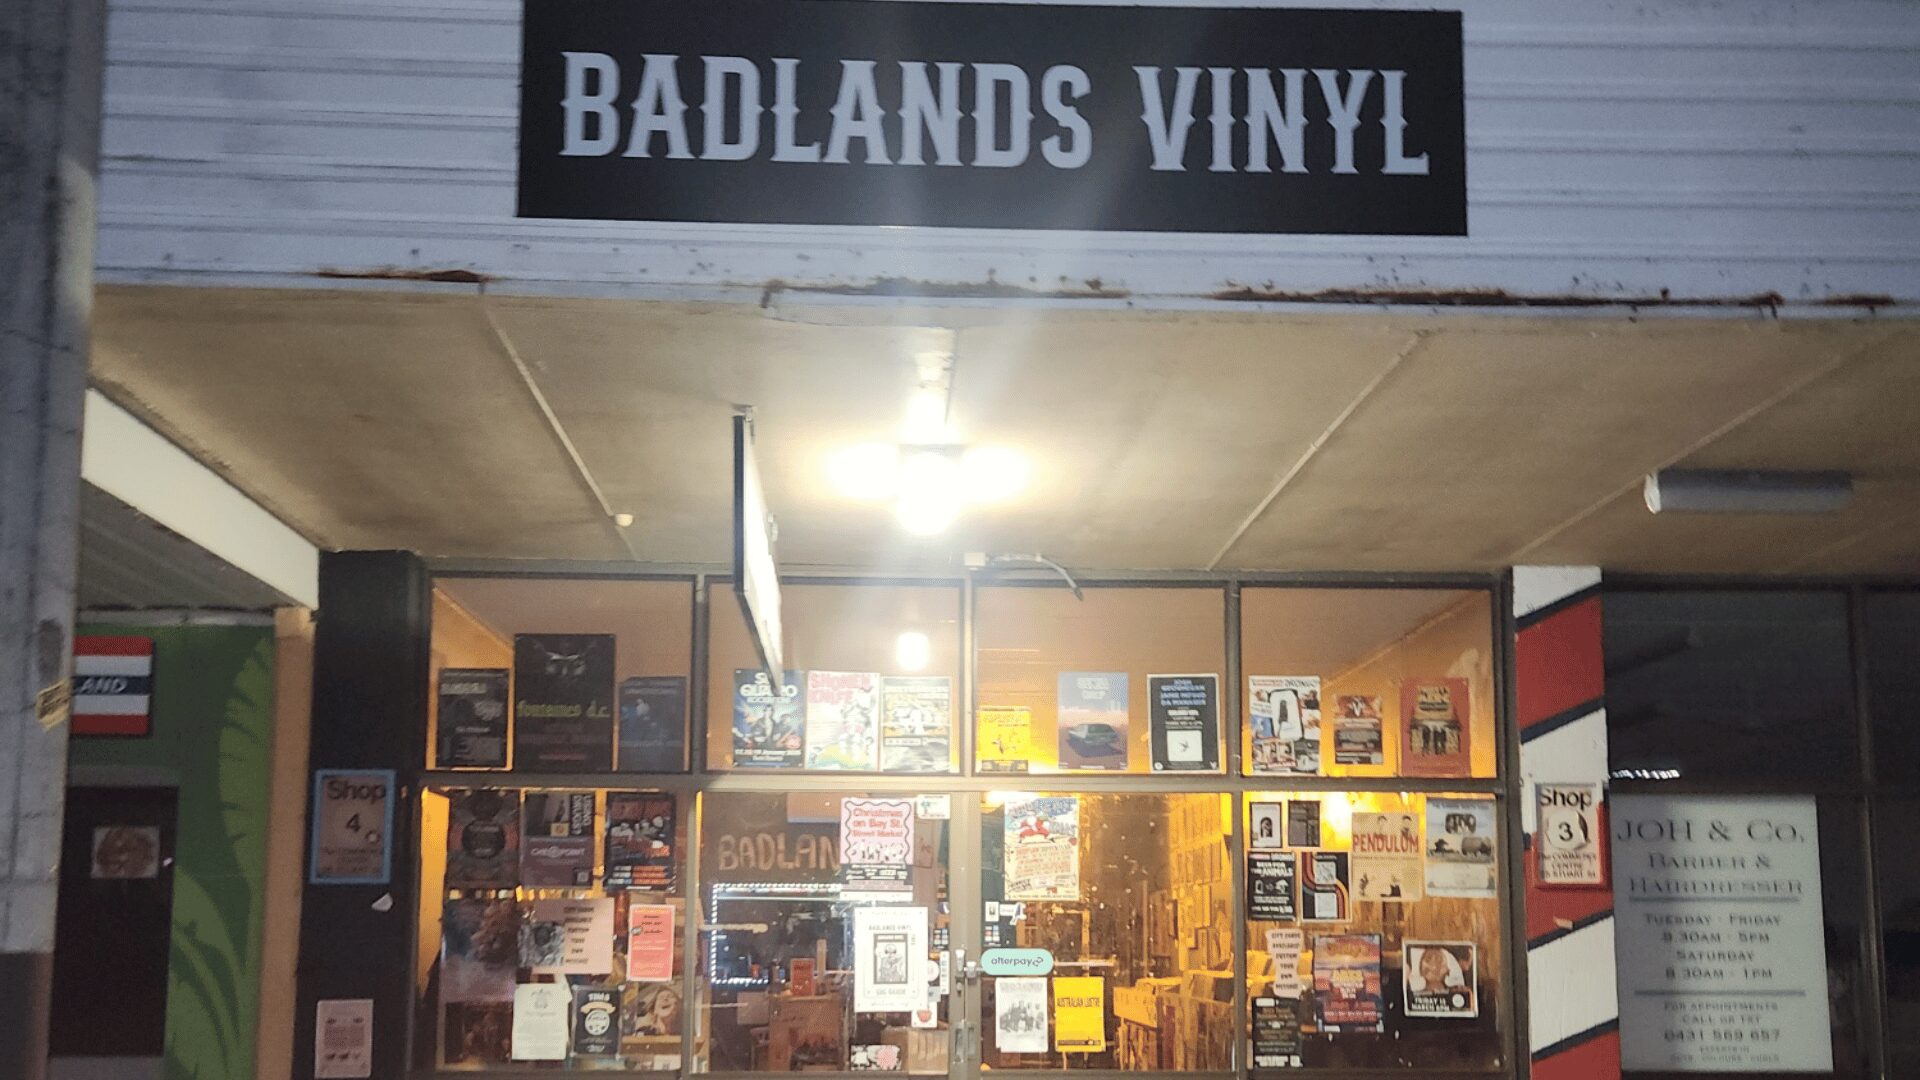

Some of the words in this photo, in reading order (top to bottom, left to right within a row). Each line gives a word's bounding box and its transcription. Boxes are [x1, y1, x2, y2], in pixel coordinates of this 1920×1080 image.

[560, 51, 1093, 169] BADLANDS
[1137, 65, 1430, 175] VINYL
[75, 677, 128, 694] AND
[327, 780, 386, 804] Shop
[1540, 787, 1592, 811] Shop
[345, 814, 361, 832] 4
[1558, 821, 1573, 842] 3
[1617, 818, 1693, 841] JOH
[1709, 819, 1730, 841] &
[1353, 831, 1419, 854] PENDULUM
[1646, 913, 1712, 926] TUESDAY
[1729, 913, 1781, 926] FRIDAY
[991, 956, 1032, 968] afterpay
[1676, 950, 1754, 962] SATURDAY
